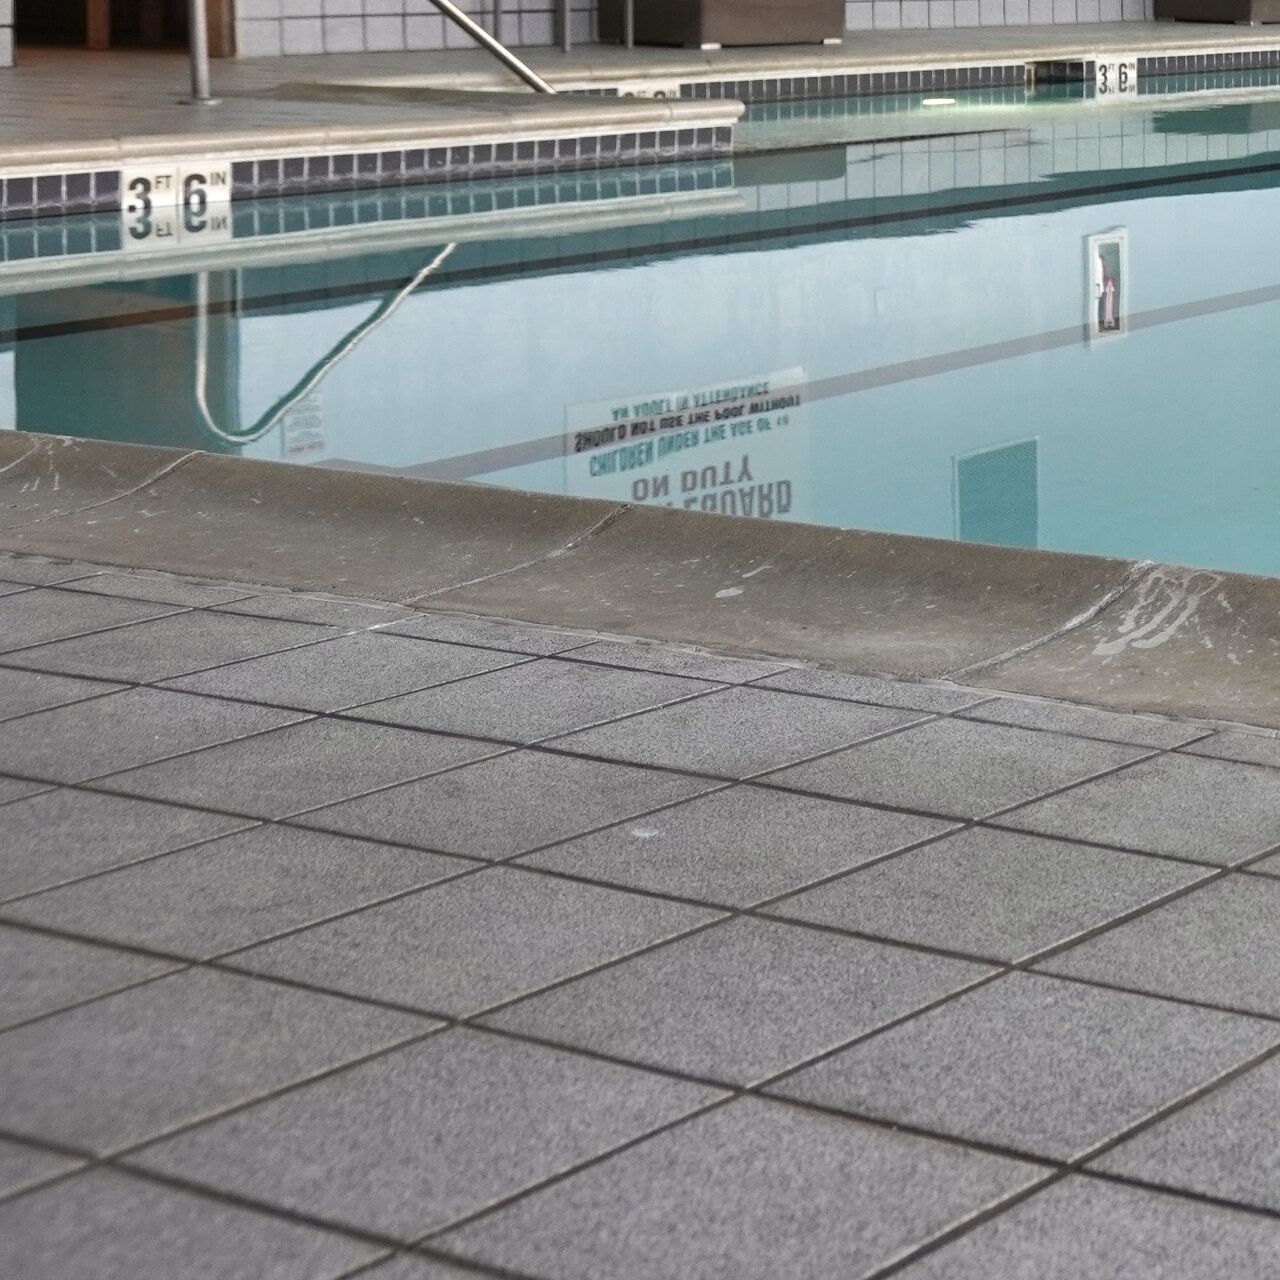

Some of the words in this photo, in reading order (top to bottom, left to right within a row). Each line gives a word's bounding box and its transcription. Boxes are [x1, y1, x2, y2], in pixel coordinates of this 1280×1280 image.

[1098, 64, 1107, 81] 3
[1119, 63, 1128, 81] 6
[128, 177, 152, 212] 3
[155, 175, 172, 189] FT
[184, 174, 207, 208] 6
[210, 171, 227, 185] IN
